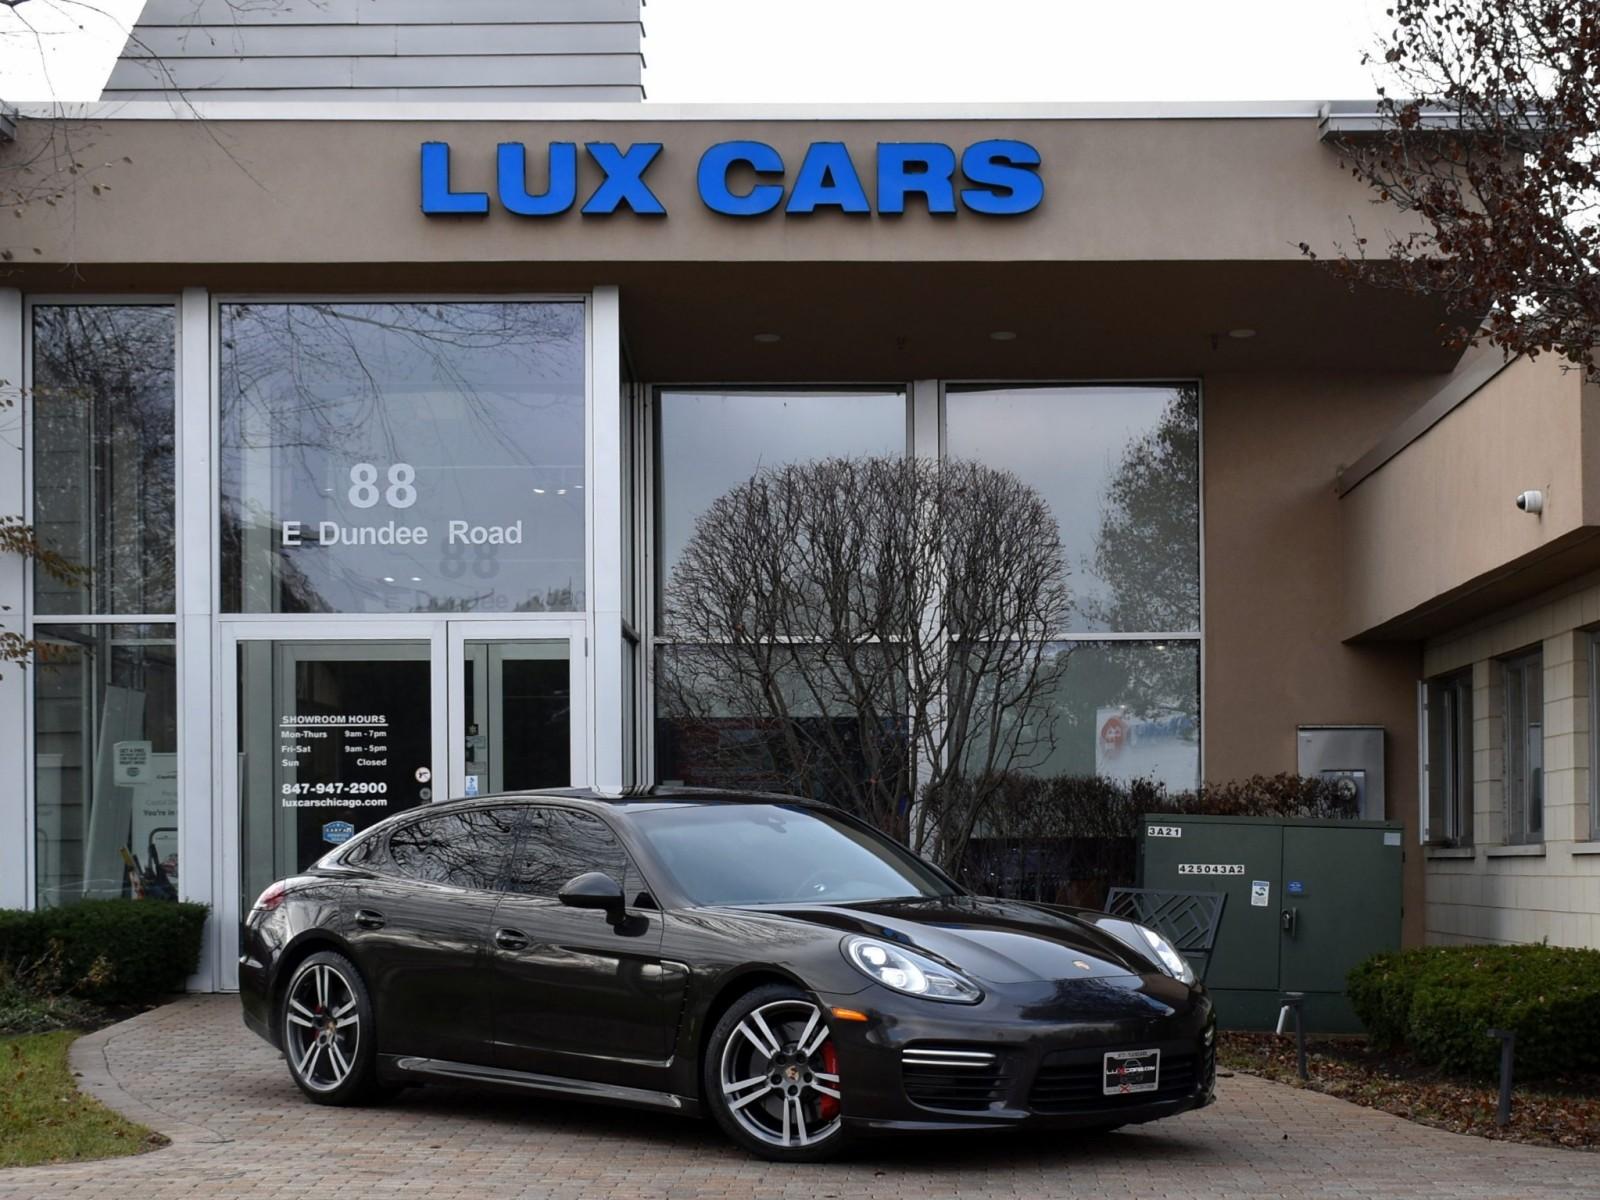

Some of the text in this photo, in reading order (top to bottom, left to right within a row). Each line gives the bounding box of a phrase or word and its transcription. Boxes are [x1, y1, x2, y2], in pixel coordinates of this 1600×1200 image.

[421, 139, 1045, 216] LUX CARS
[348, 463, 417, 509] 88
[282, 520, 522, 546] E Dundee Road
[282, 715, 387, 724] SHOWROOM HOURS
[281, 730, 328, 739] Mon-Thurs
[344, 730, 362, 738] 9am
[369, 730, 387, 739] 7pm
[281, 745, 312, 753] Fri-Sat
[344, 745, 362, 753] 9am
[369, 745, 387, 753] 5pm
[281, 758, 387, 767] Sun Closed
[281, 782, 388, 795] 847-947-2900
[281, 798, 388, 808] luxcarschicago.com
[1149, 828, 1180, 836] 3A21
[1179, 865, 1243, 874] 425043A2
